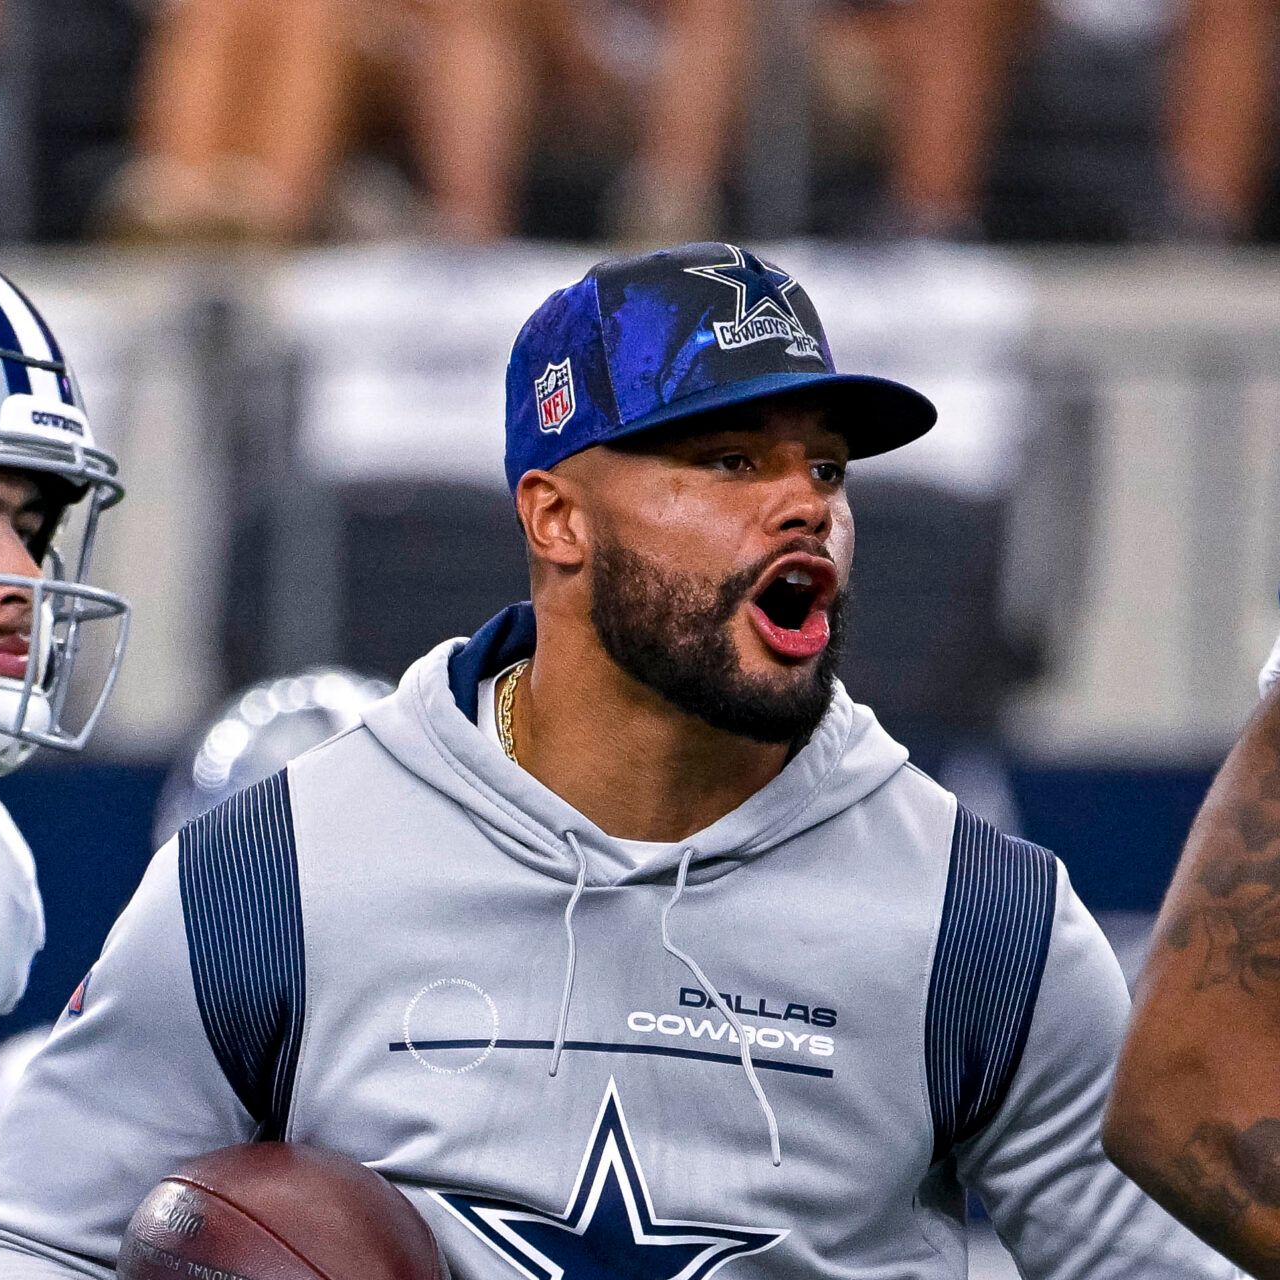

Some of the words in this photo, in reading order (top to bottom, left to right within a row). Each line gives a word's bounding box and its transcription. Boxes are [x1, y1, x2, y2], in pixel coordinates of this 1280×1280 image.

[720, 318, 790, 346] COWBOYS
[792, 334, 817, 353] NFC
[542, 388, 570, 425] NFL
[678, 986, 838, 1029] DALLAS
[626, 1011, 835, 1057] COWBOYS
